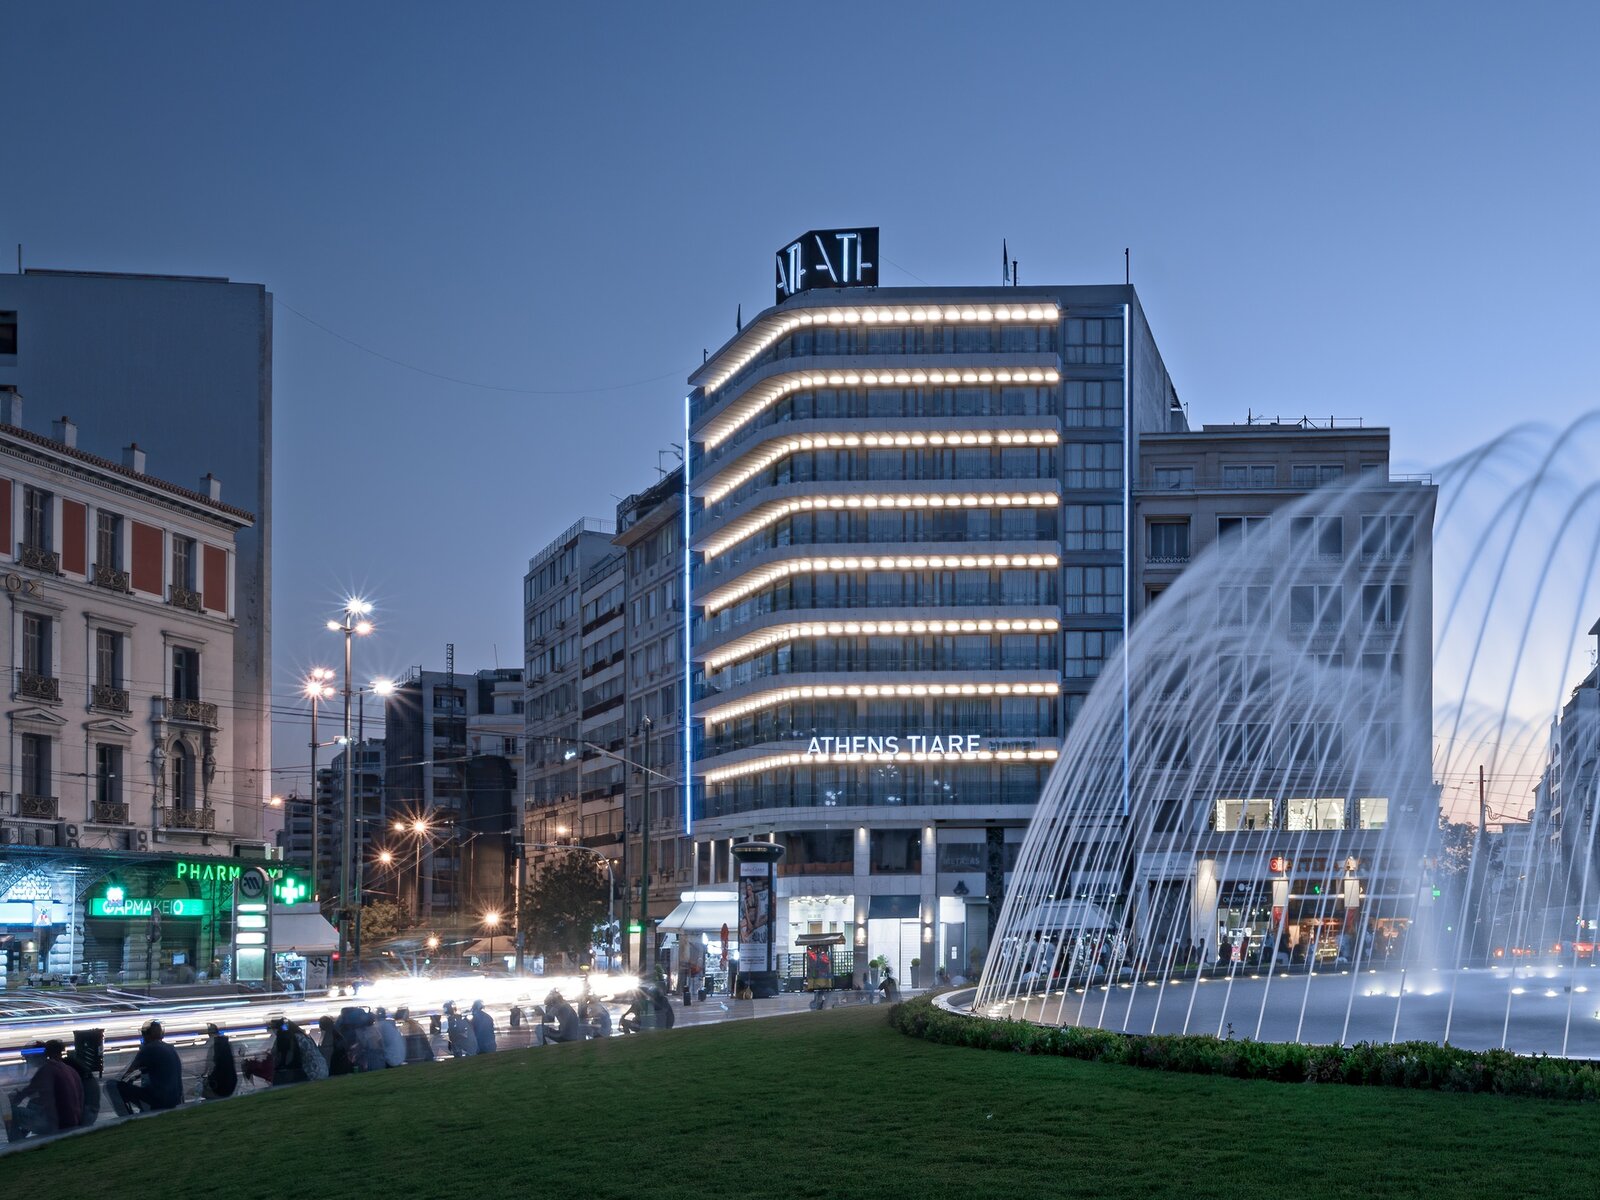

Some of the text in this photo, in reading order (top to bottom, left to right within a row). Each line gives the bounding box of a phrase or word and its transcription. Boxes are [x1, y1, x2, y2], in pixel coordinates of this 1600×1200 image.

[807, 734, 981, 755] ATHENS TIARE
[177, 862, 278, 881] PHARMY
